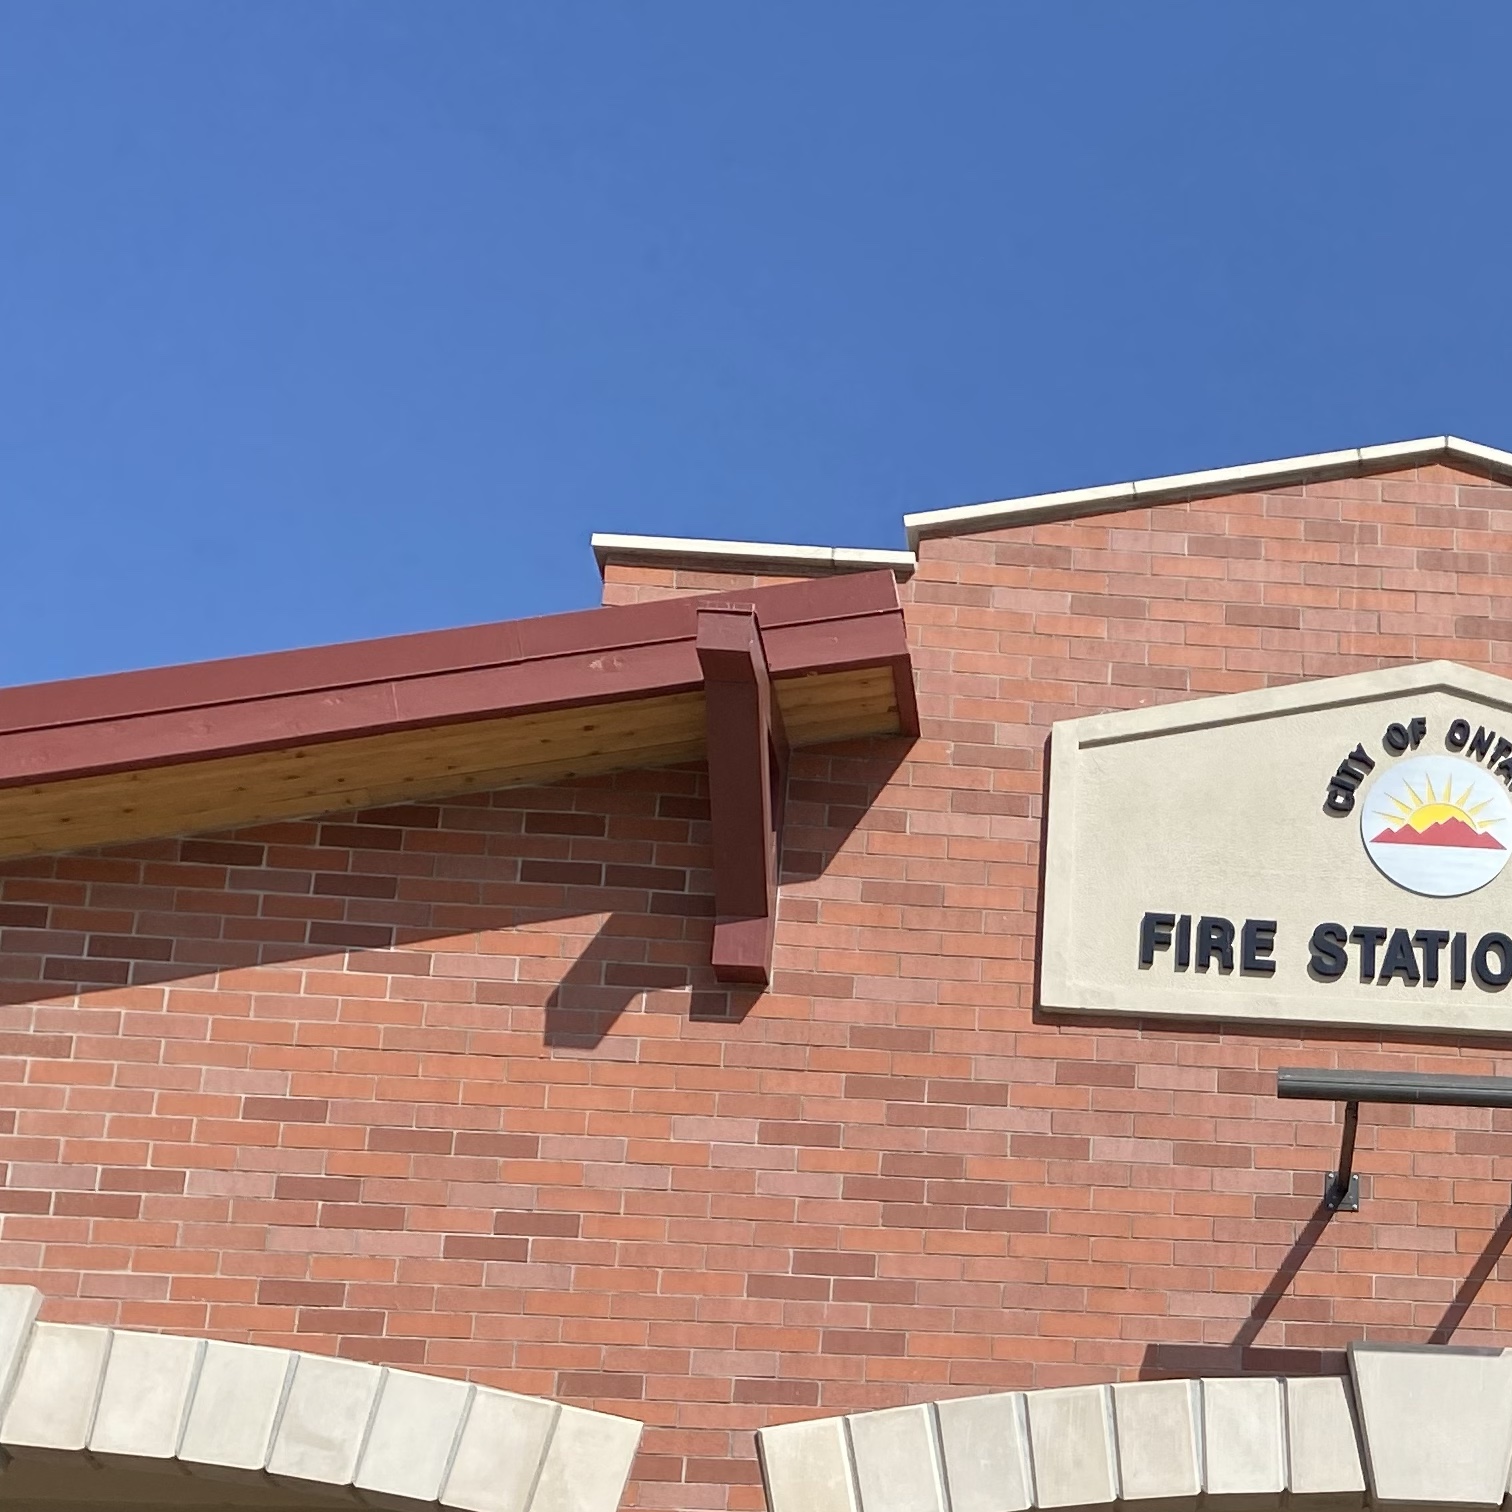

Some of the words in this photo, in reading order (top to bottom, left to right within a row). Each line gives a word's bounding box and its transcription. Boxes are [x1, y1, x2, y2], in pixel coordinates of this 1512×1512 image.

[1324, 743, 1375, 817] CITY
[1383, 717, 1427, 756] OF
[1139, 911, 1277, 978] FIRE
